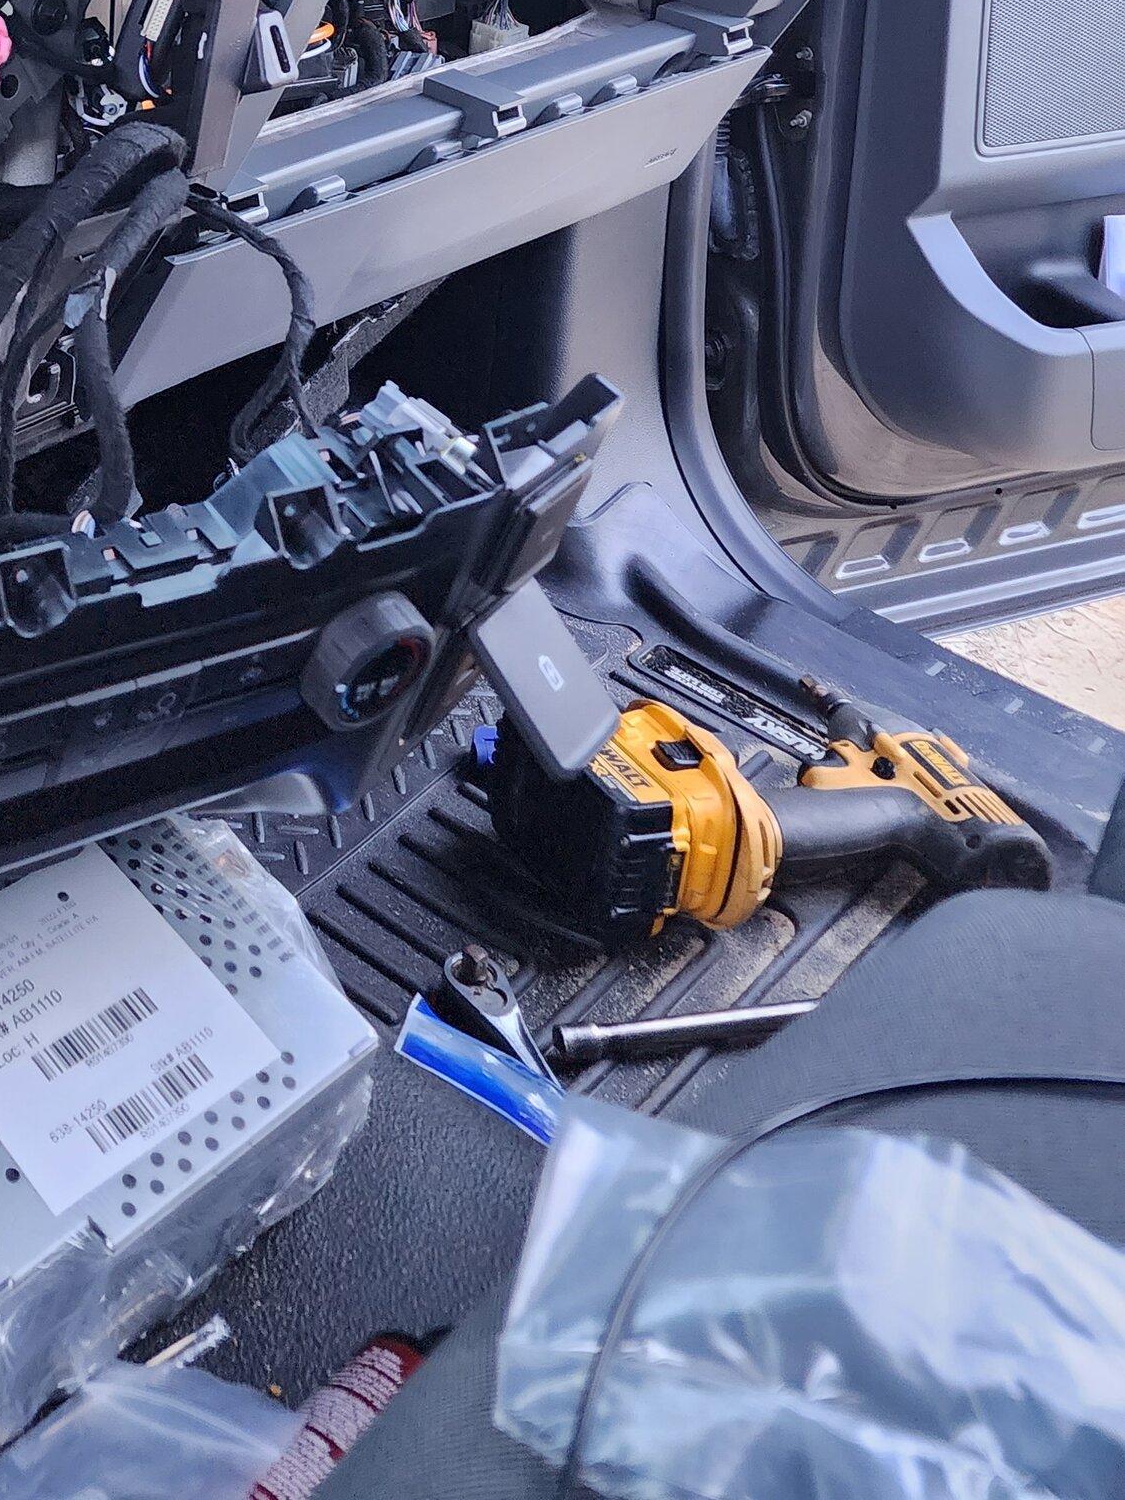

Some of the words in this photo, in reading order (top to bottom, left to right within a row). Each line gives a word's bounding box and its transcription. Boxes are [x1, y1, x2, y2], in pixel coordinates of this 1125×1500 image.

[742, 715, 826, 761] HUSKY
[601, 749, 652, 789] WALT
[12, 989, 63, 1030] AB1110
[23, 1031, 41, 1050] H
[49, 1099, 108, 1143] 638-14250
[175, 1026, 214, 1058] AB1110
